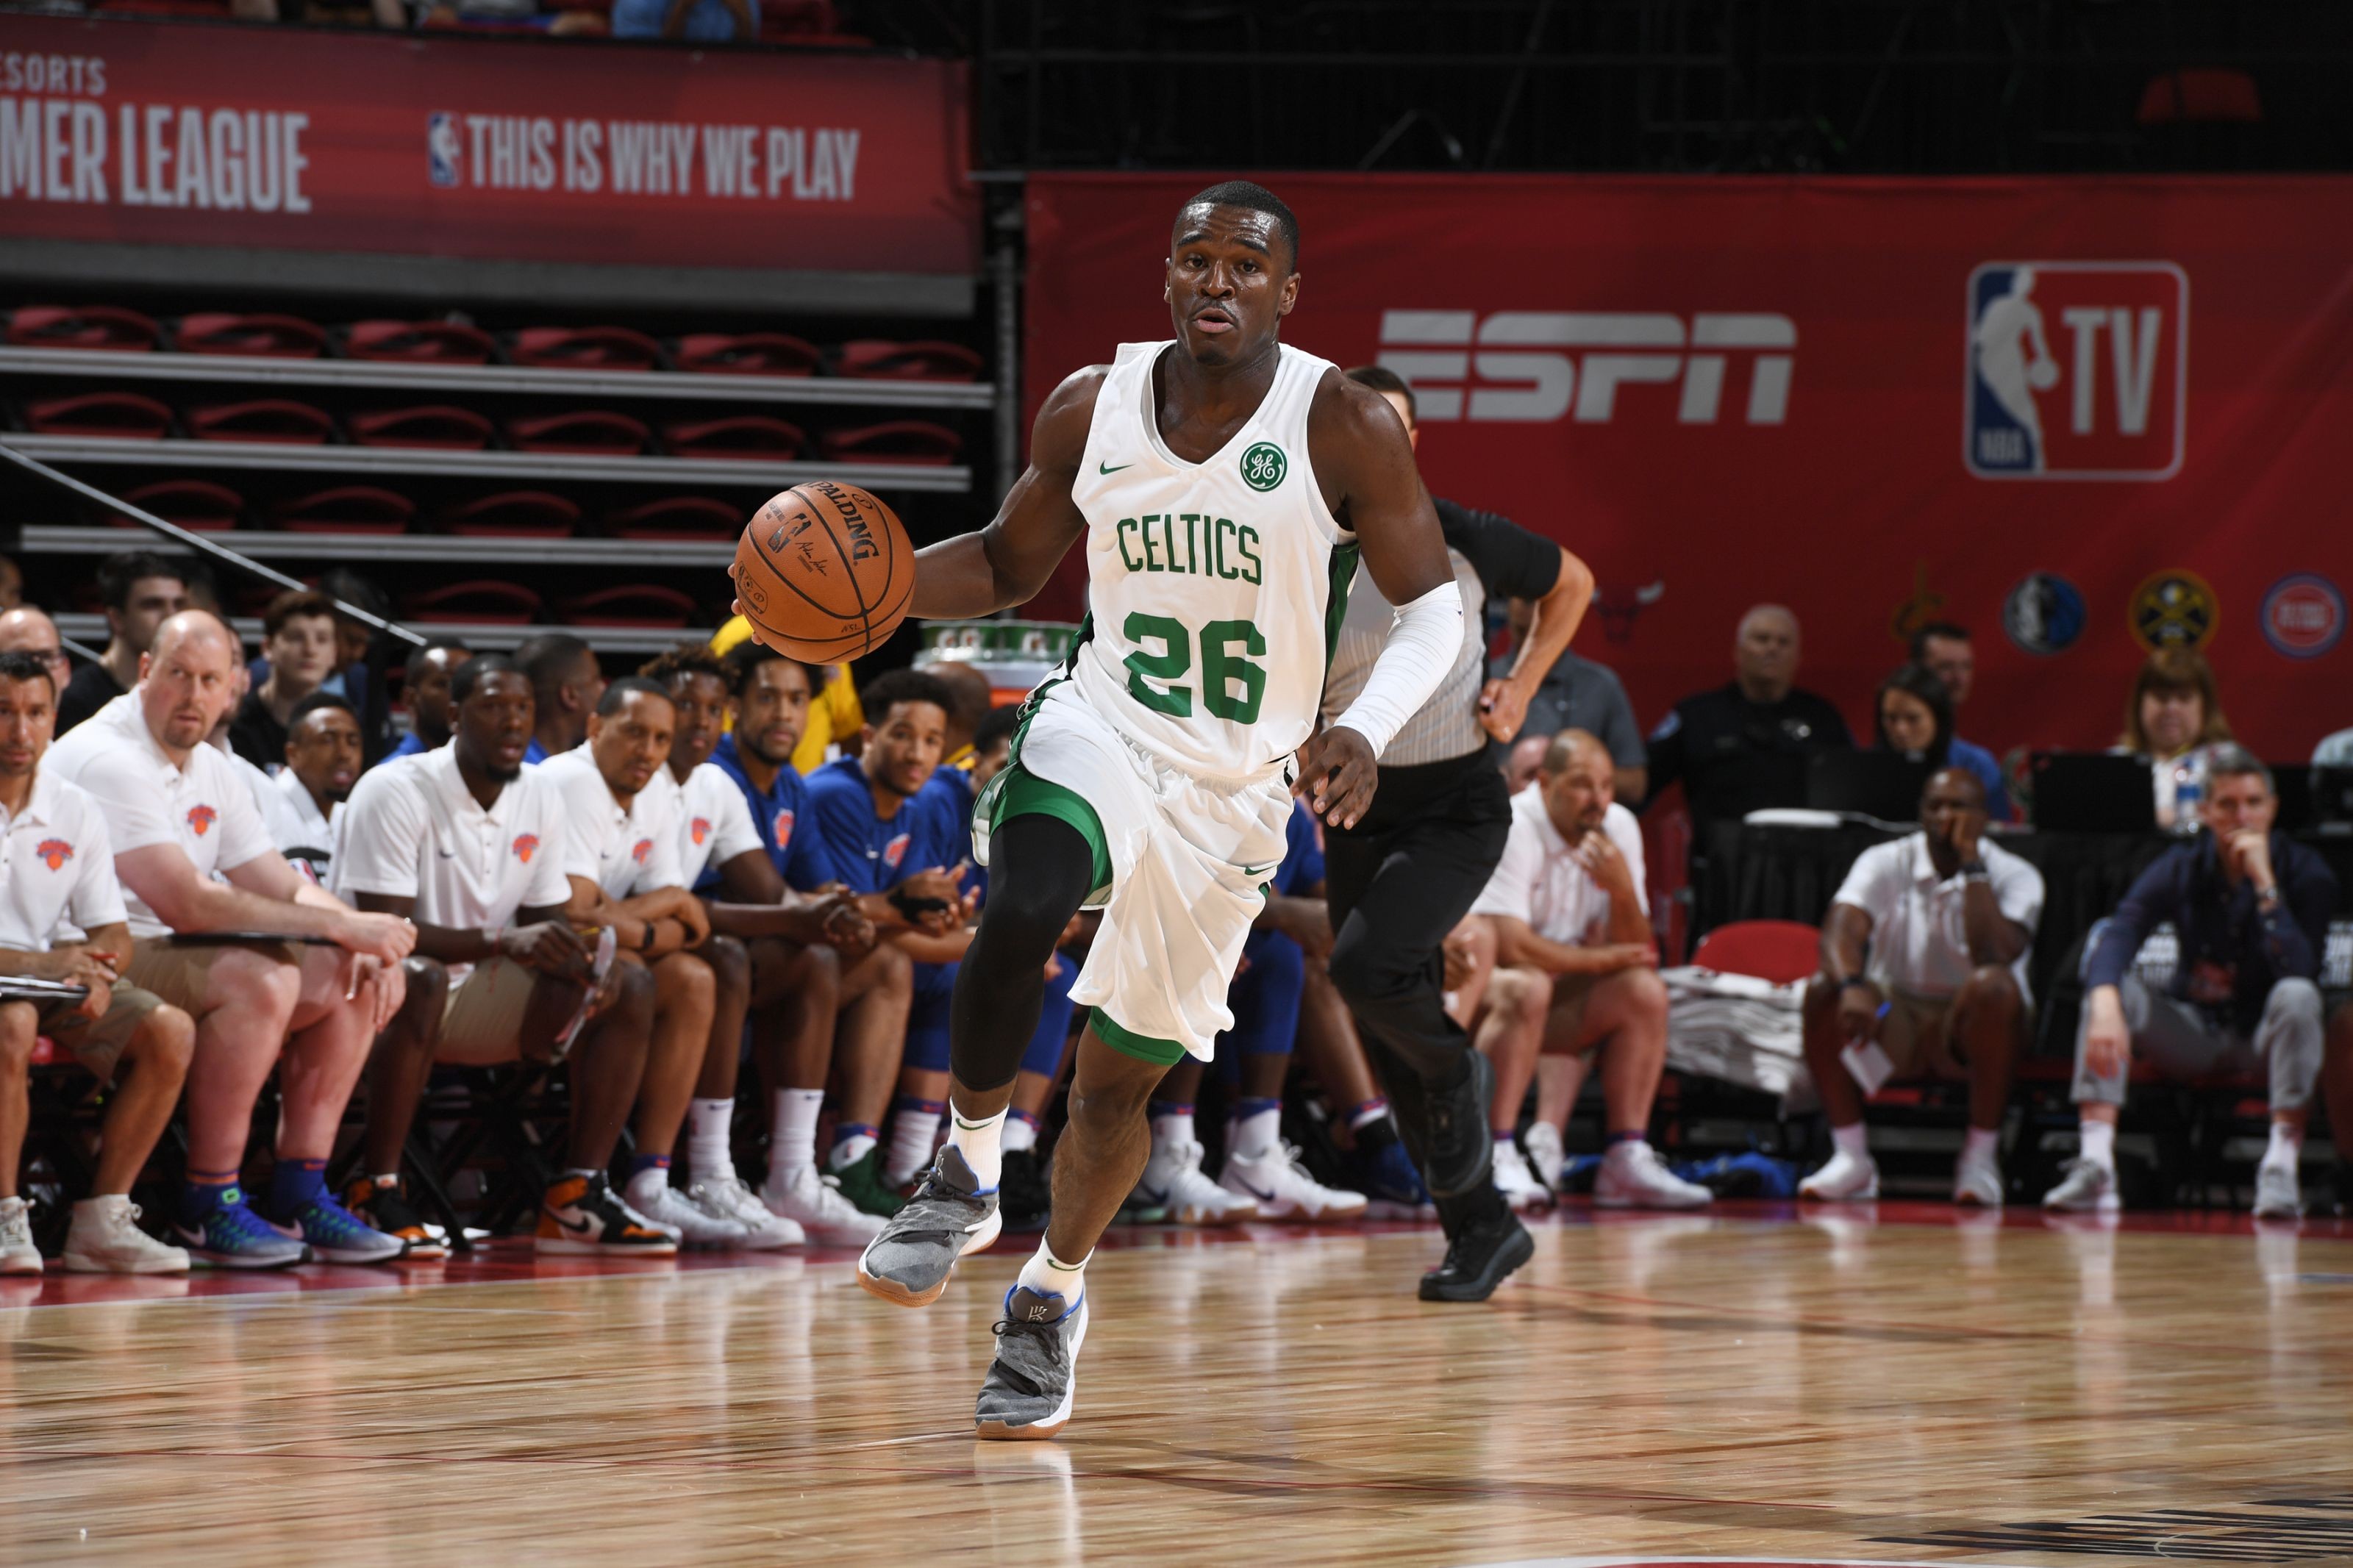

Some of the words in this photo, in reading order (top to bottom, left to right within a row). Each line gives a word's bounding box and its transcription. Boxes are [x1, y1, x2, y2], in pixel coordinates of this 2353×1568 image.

[0, 51, 107, 96] SORTS
[0, 96, 109, 203] MER
[120, 104, 311, 212] LEAGUE
[467, 115, 556, 190] THIS
[563, 120, 603, 192] IS
[609, 121, 696, 195] WHY
[703, 125, 760, 198] WE
[767, 126, 860, 200] PLAY
[1377, 309, 1796, 424] ESPN
[2062, 307, 2162, 435] TV
[1116, 514, 1262, 587] CELTICS
[1122, 611, 1267, 725] 26
